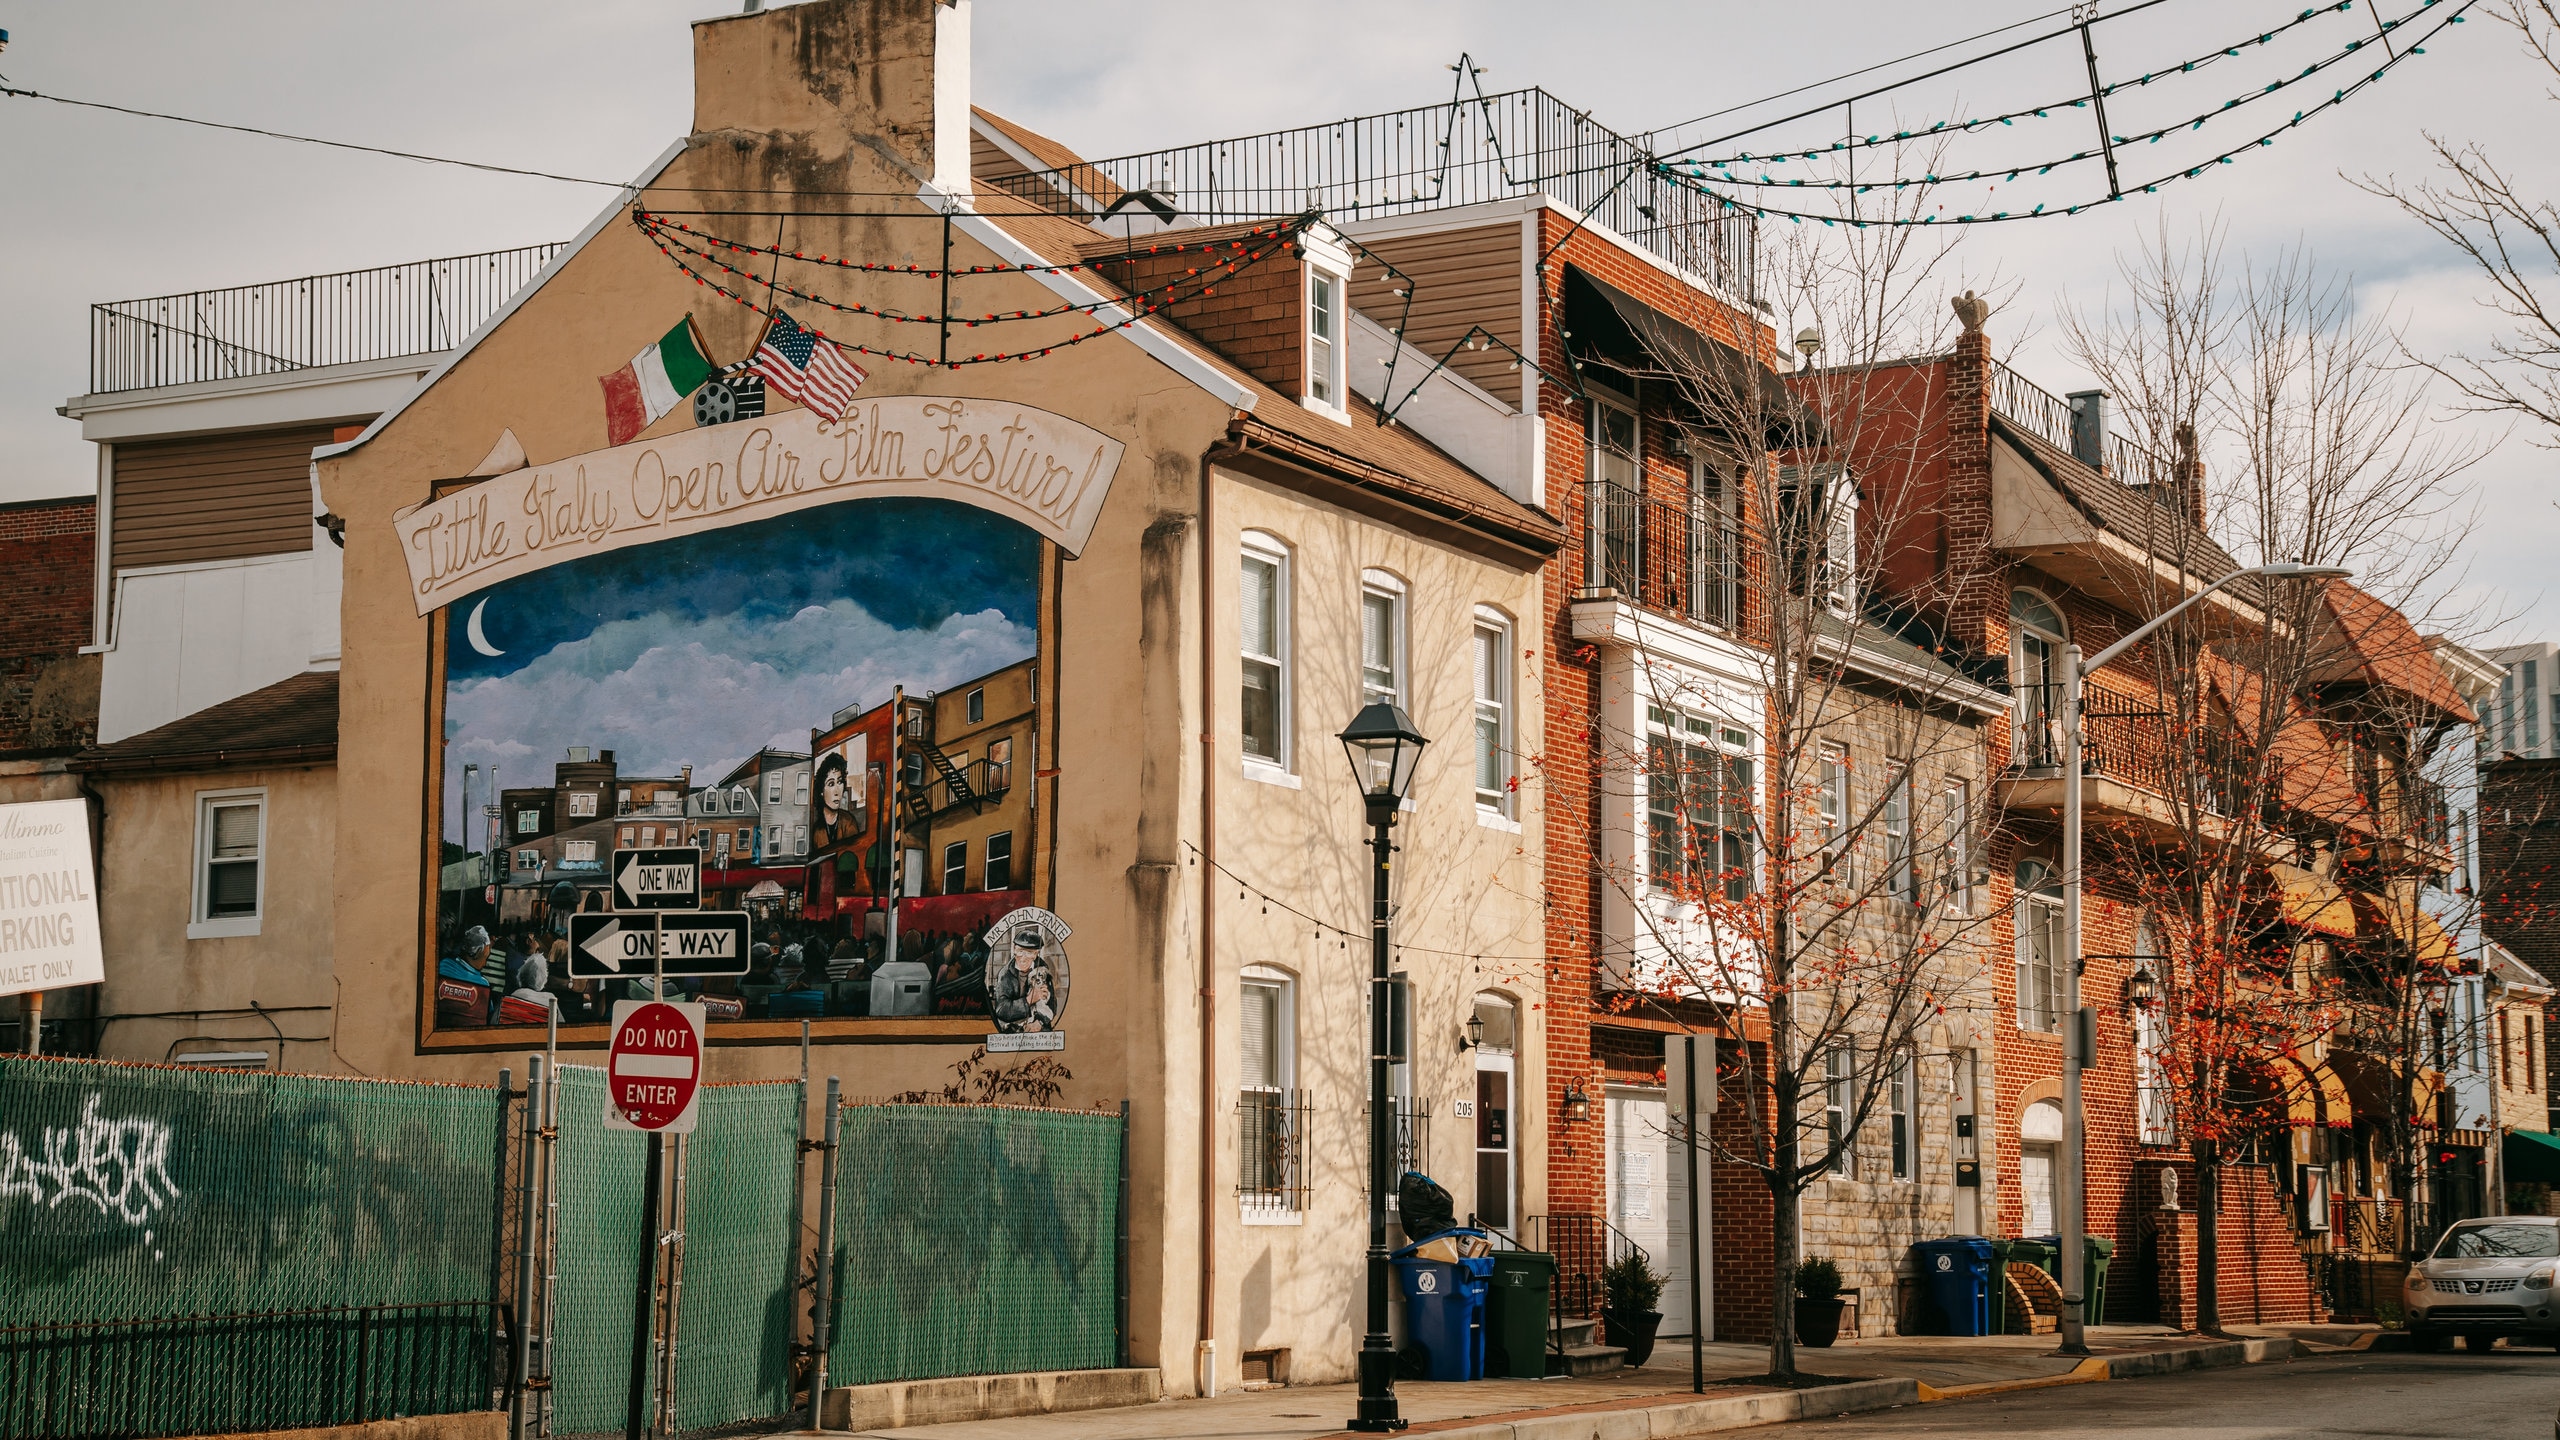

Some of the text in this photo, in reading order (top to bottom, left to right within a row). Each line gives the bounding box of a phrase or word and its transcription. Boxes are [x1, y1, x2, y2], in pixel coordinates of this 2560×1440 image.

[412, 399, 1104, 595] Little Italy Open Air Film Festival
[639, 867, 691, 891] ONE WAY
[0, 912, 75, 953] RKING
[987, 909, 1069, 944] MR JOHN PENTE
[623, 932, 729, 956] ONE WAY
[0, 959, 74, 986] VALET ONLY
[444, 986, 472, 998] PERONI
[702, 1002, 738, 1015] ERONI
[625, 1027, 689, 1049] DO NOT
[626, 1084, 677, 1105] ENTER
[1457, 1101, 1473, 1117] 205
